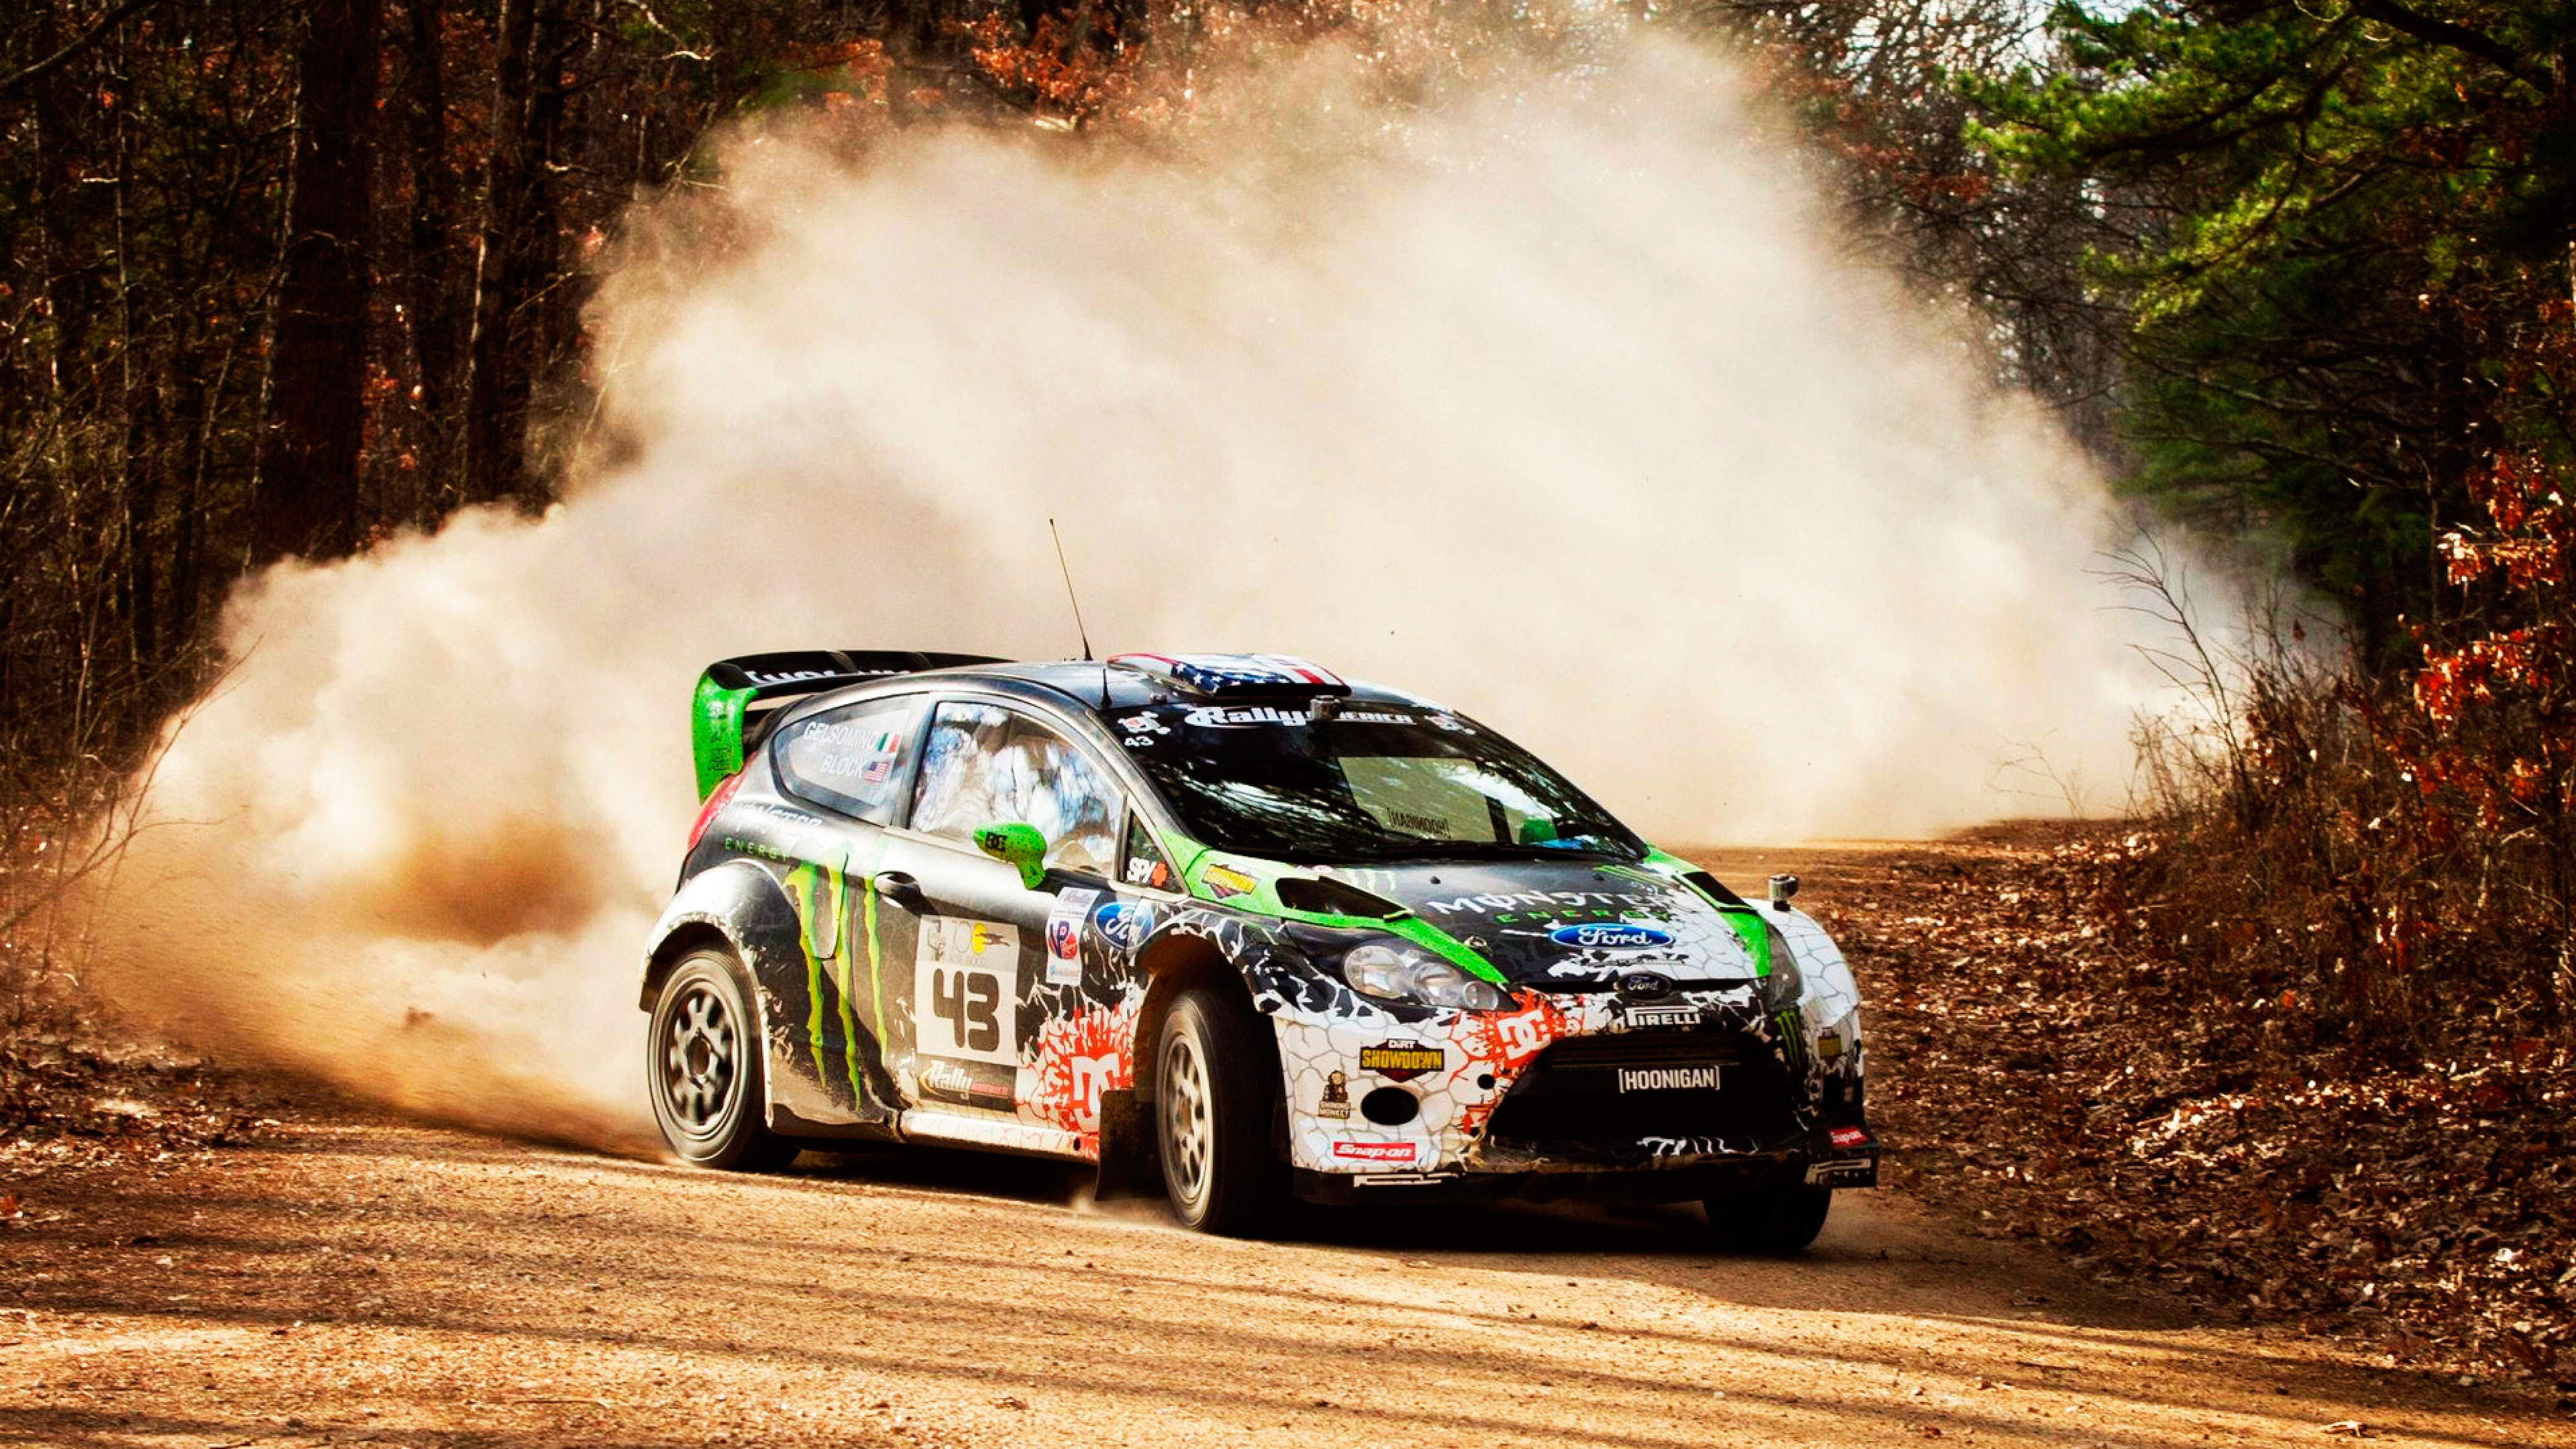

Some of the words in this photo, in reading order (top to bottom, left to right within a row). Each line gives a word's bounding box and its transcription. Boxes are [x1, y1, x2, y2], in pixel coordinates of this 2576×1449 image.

[1185, 706, 1307, 727] Rally
[1124, 736, 1155, 747] 43
[1576, 925, 1653, 946] Ford
[1626, 975, 1659, 991] Ford
[933, 968, 1000, 1052] 43
[1625, 1006, 1701, 1027] PIRELLI
[1361, 1049, 1442, 1069] SHOWDOWN
